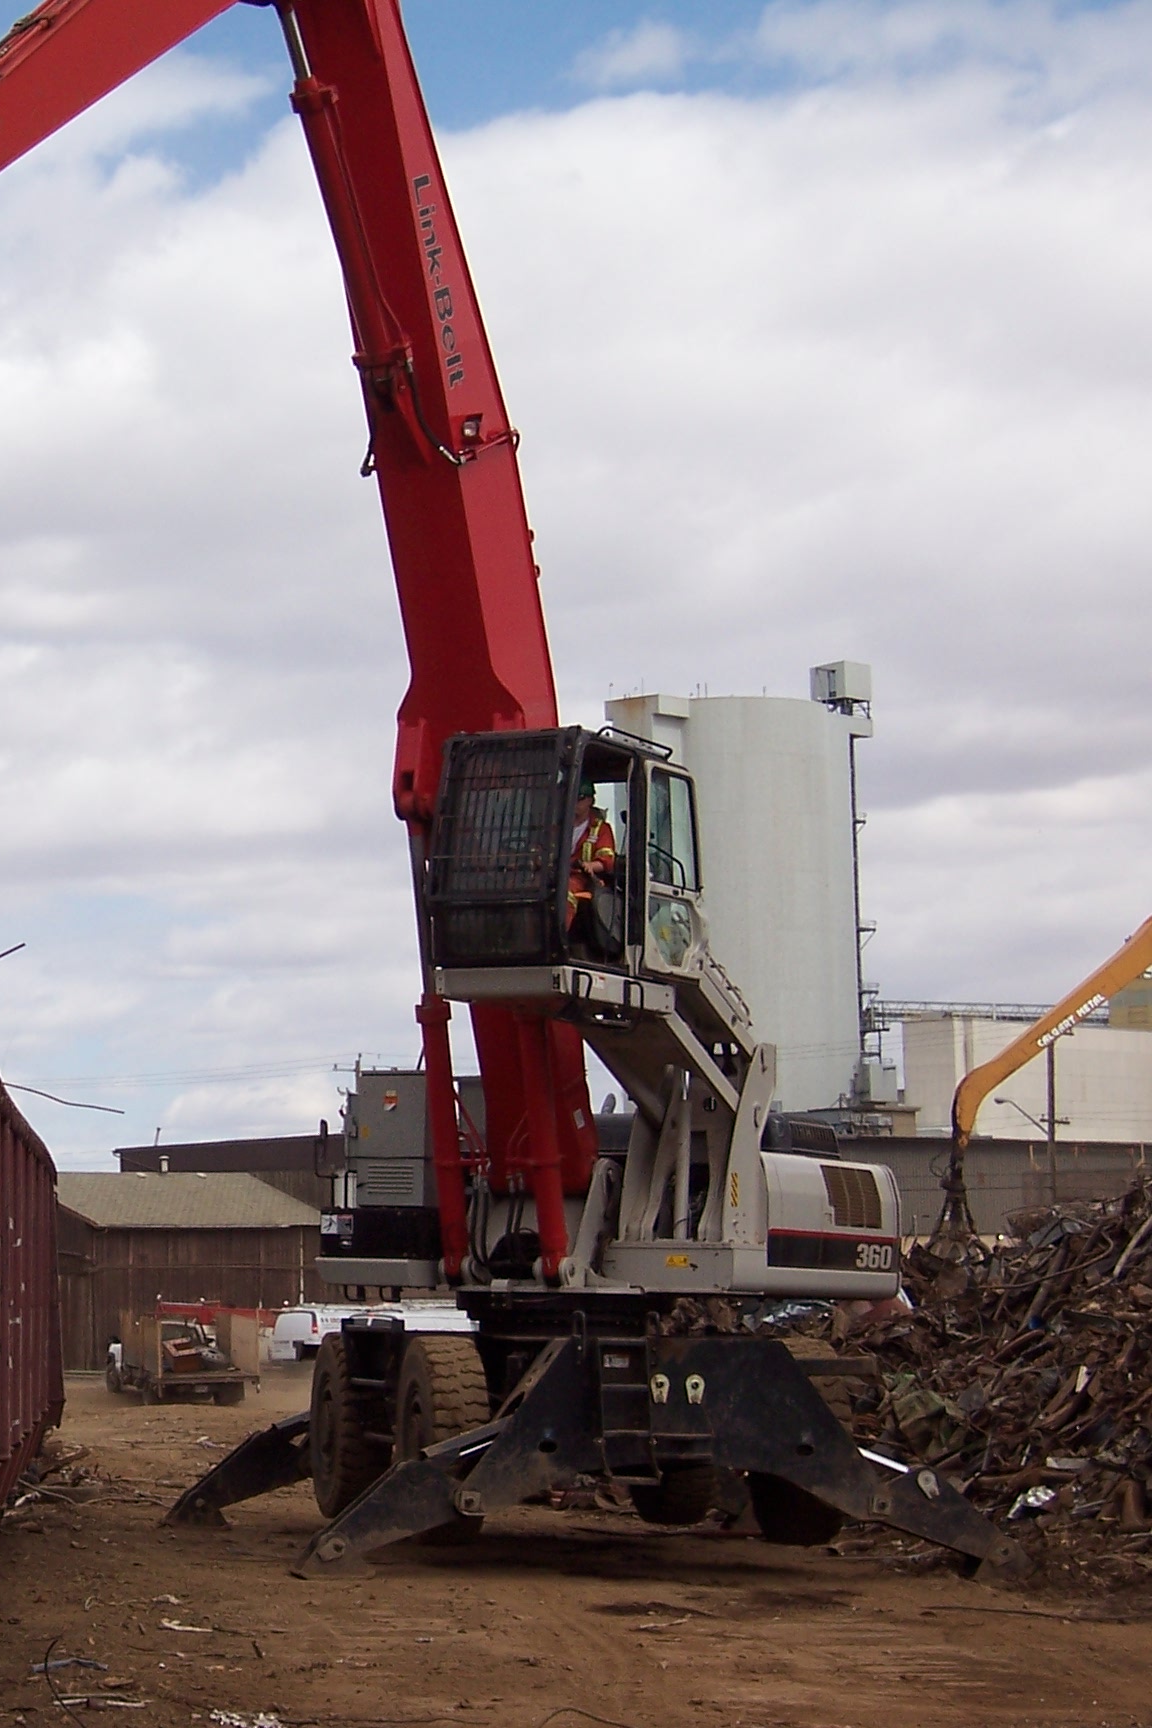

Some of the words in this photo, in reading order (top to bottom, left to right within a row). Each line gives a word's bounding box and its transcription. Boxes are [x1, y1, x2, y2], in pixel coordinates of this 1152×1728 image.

[413, 174, 464, 388] Link-Belt
[1037, 1015, 1076, 1047] CALGARY
[1076, 994, 1106, 1017] METAL
[855, 1243, 892, 1269] 360
